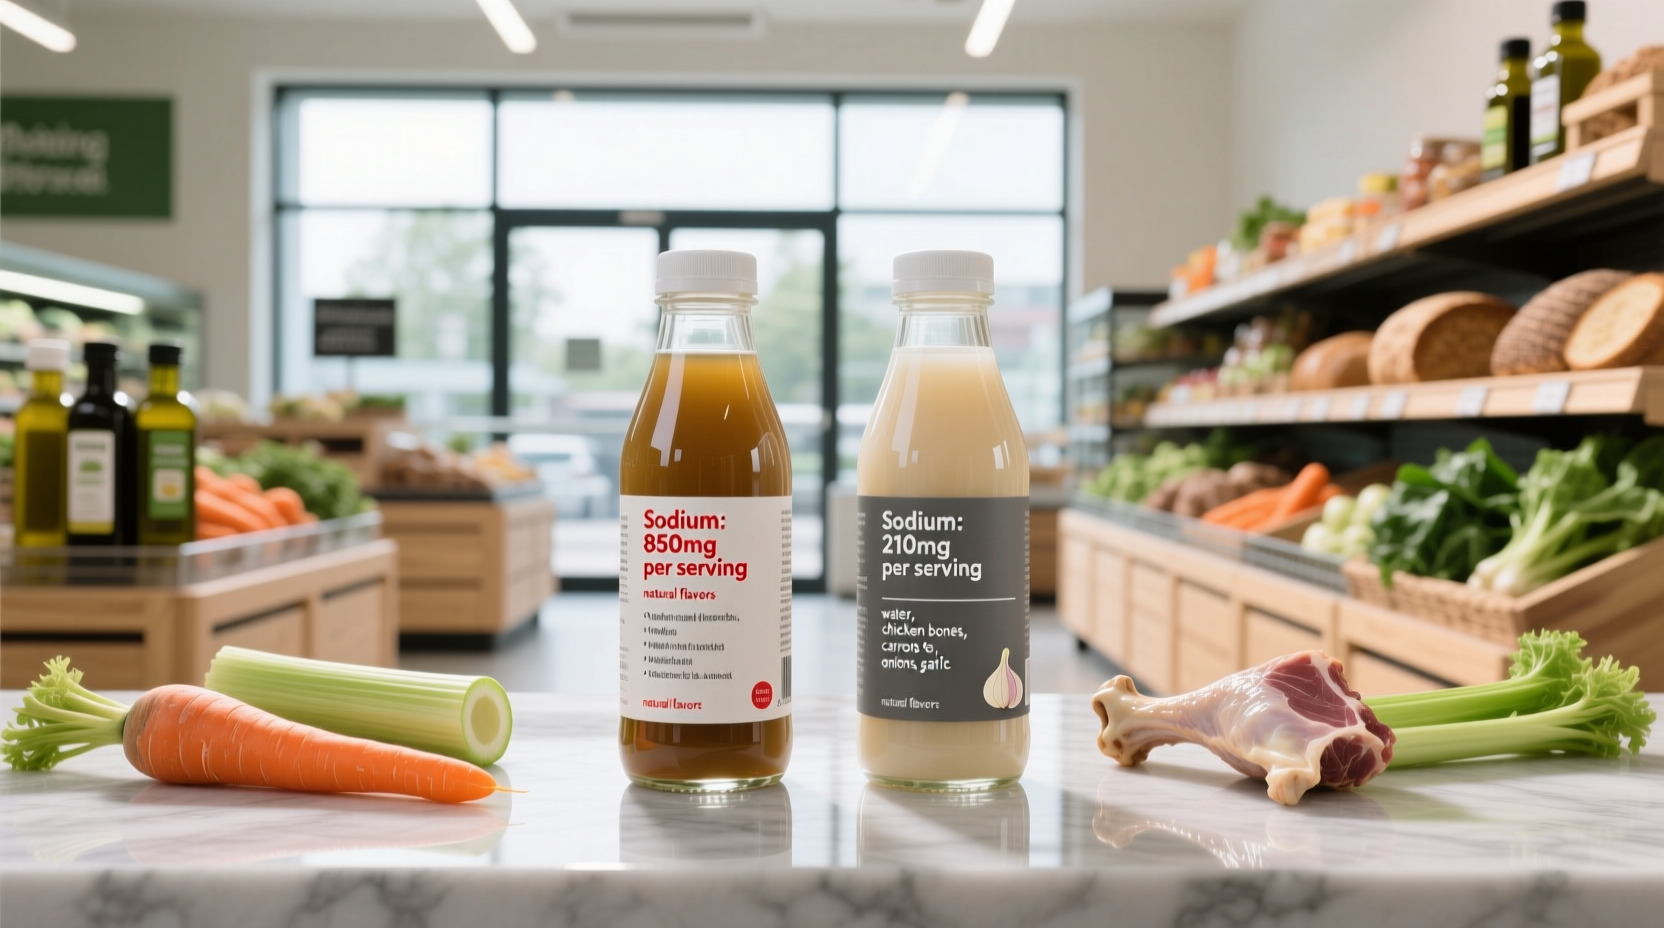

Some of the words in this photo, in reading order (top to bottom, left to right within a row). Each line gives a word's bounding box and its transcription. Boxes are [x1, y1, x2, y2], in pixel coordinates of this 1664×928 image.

[643, 509, 726, 530] Sodium:
[882, 510, 963, 531] Sodium:
[643, 534, 717, 558] 850mg
[882, 534, 951, 559] 210mg
[643, 562, 672, 580] per
[677, 558, 748, 581] serving
[882, 562, 910, 581] per
[914, 558, 982, 582] serving
[643, 587, 677, 599] natural
[680, 587, 717, 600] flavors
[881, 622, 925, 637] chicken
[928, 623, 968, 640] bones,
